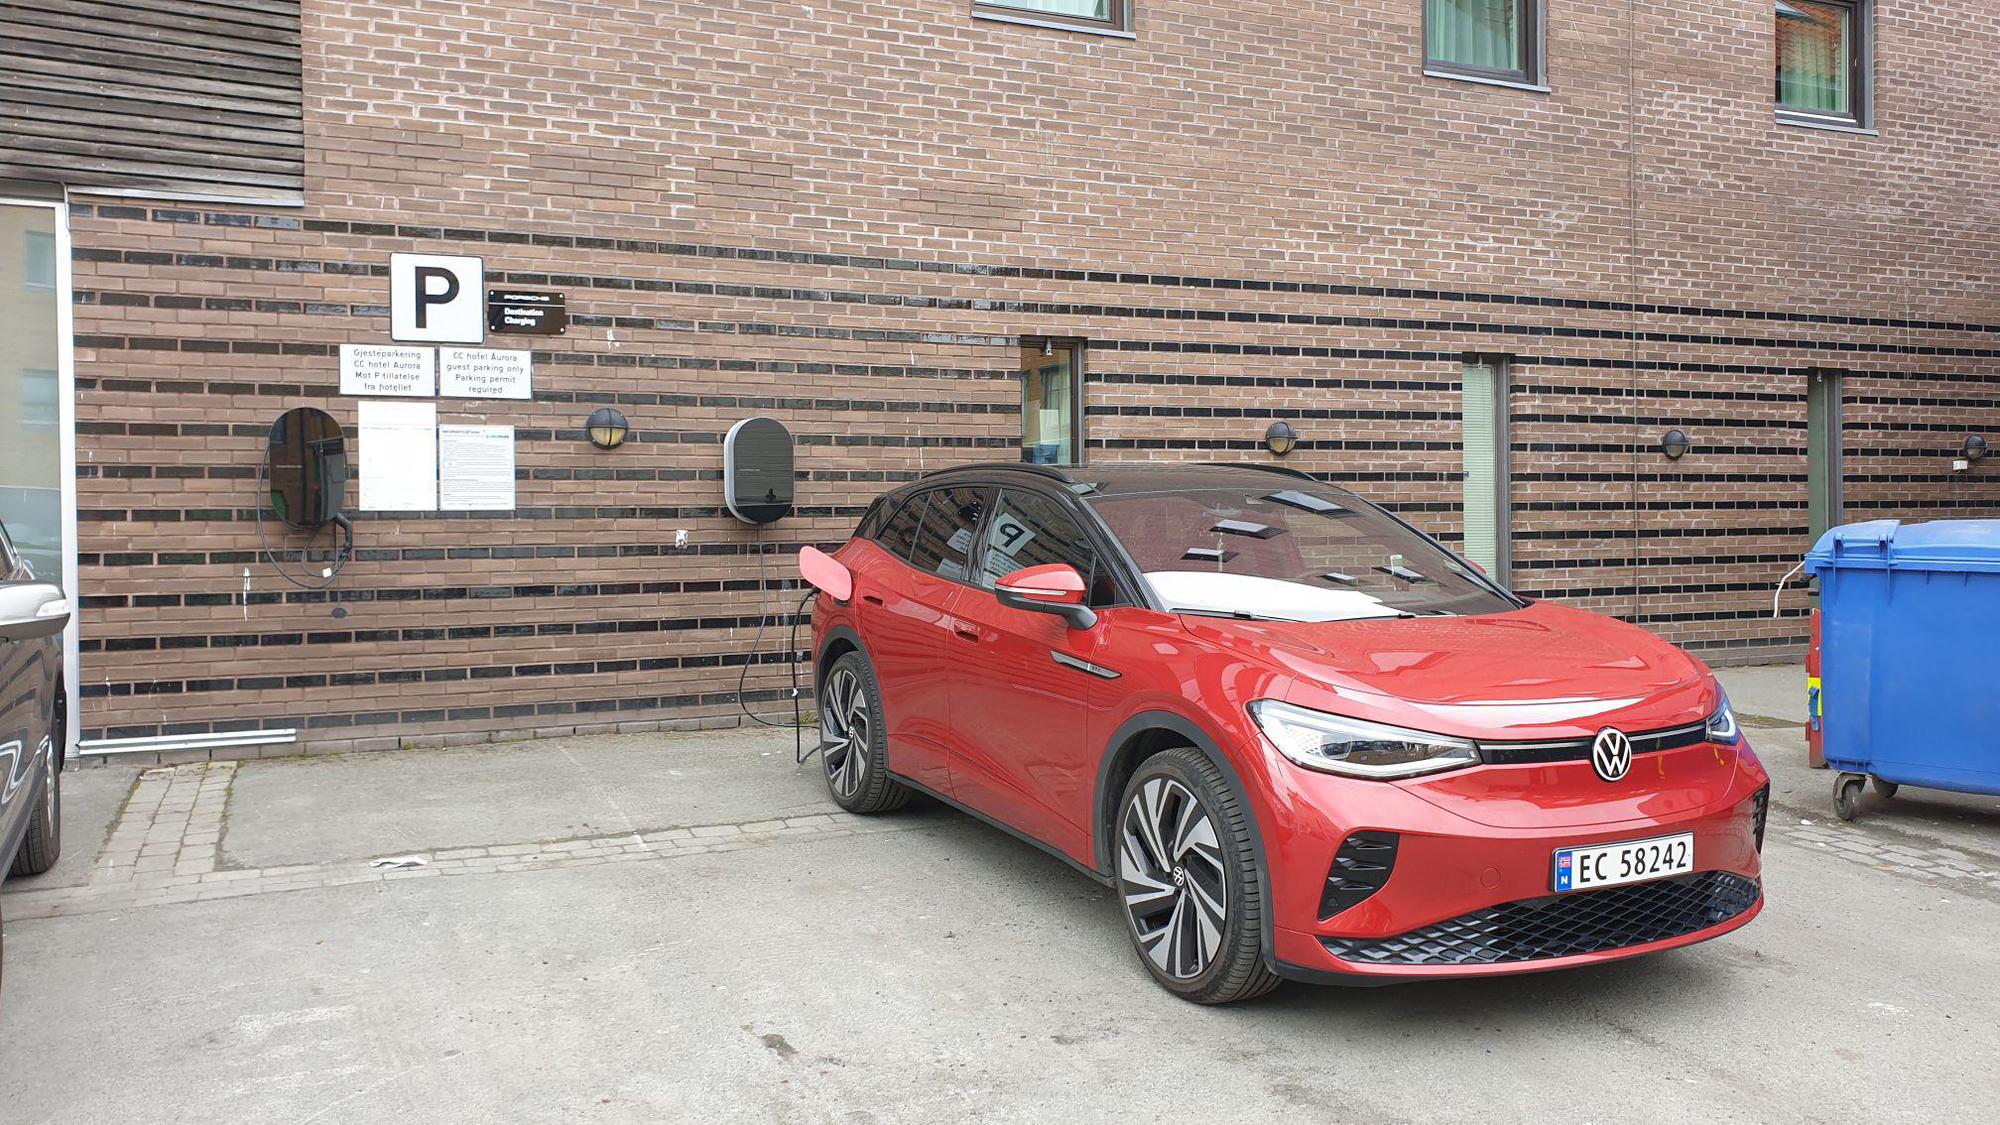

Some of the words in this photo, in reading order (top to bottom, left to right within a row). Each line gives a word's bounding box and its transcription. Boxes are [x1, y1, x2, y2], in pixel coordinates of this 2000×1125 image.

[415, 265, 460, 329] P
[504, 307, 544, 316] Destination
[504, 316, 536, 326] Charging
[353, 348, 421, 360] Gjesteparkering
[453, 351, 464, 360] CC
[466, 352, 488, 361] hotel
[490, 352, 518, 362] Aurora
[353, 360, 365, 368] CC
[368, 360, 390, 369] hotel
[393, 361, 421, 370] Aurora
[446, 363, 470, 372] guest
[473, 364, 504, 374] parking
[507, 365, 524, 375] only
[355, 371, 371, 379] Mot
[455, 373, 487, 384] Parking
[489, 375, 516, 384] permit
[364, 383, 376, 391] fra
[379, 383, 412, 392] hotellet
[468, 385, 503, 395] required
[1560, 875, 1568, 884] N
[1579, 852, 1608, 883] EC
[1620, 841, 1687, 878] 58242
